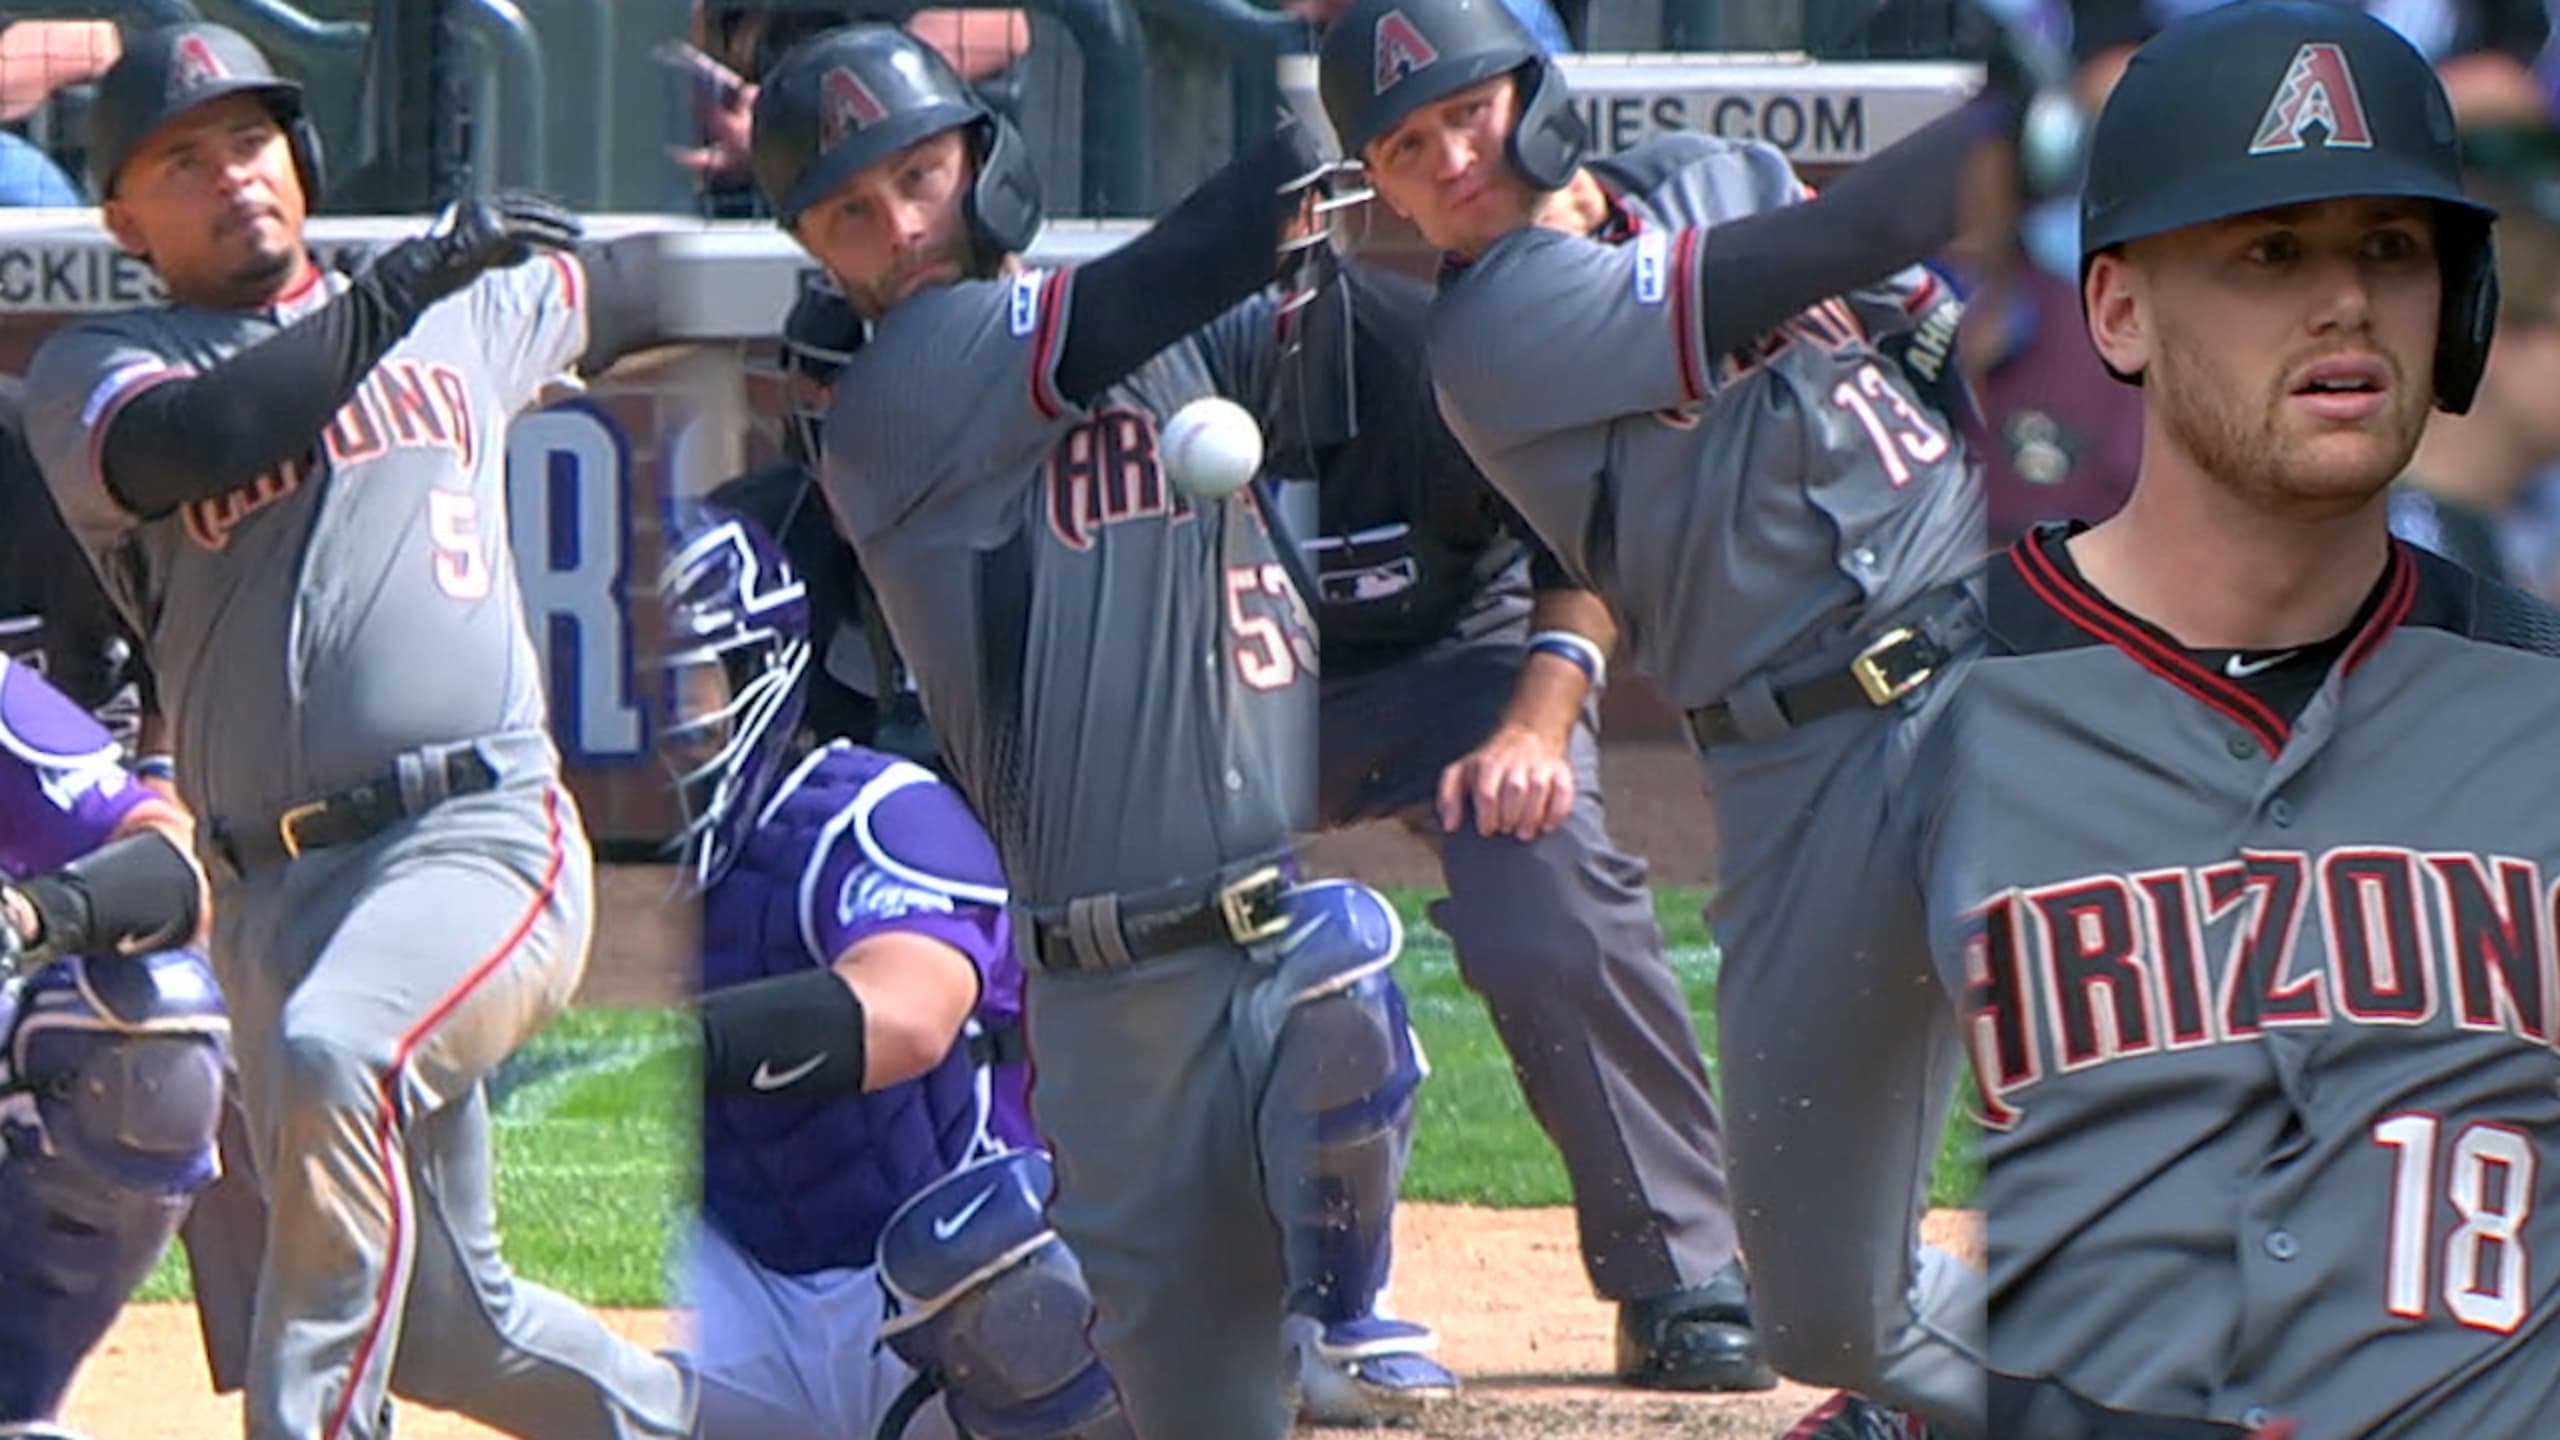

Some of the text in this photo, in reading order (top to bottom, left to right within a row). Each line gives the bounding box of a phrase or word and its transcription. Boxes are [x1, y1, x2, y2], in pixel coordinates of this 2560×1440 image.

[2248, 42, 2373, 155] A
[1833, 363, 1948, 487] 13
[429, 489, 494, 601] 5
[1226, 563, 1318, 691] 53
[1958, 845, 2560, 1131] ARIZON
[2372, 1111, 2538, 1336] 18
